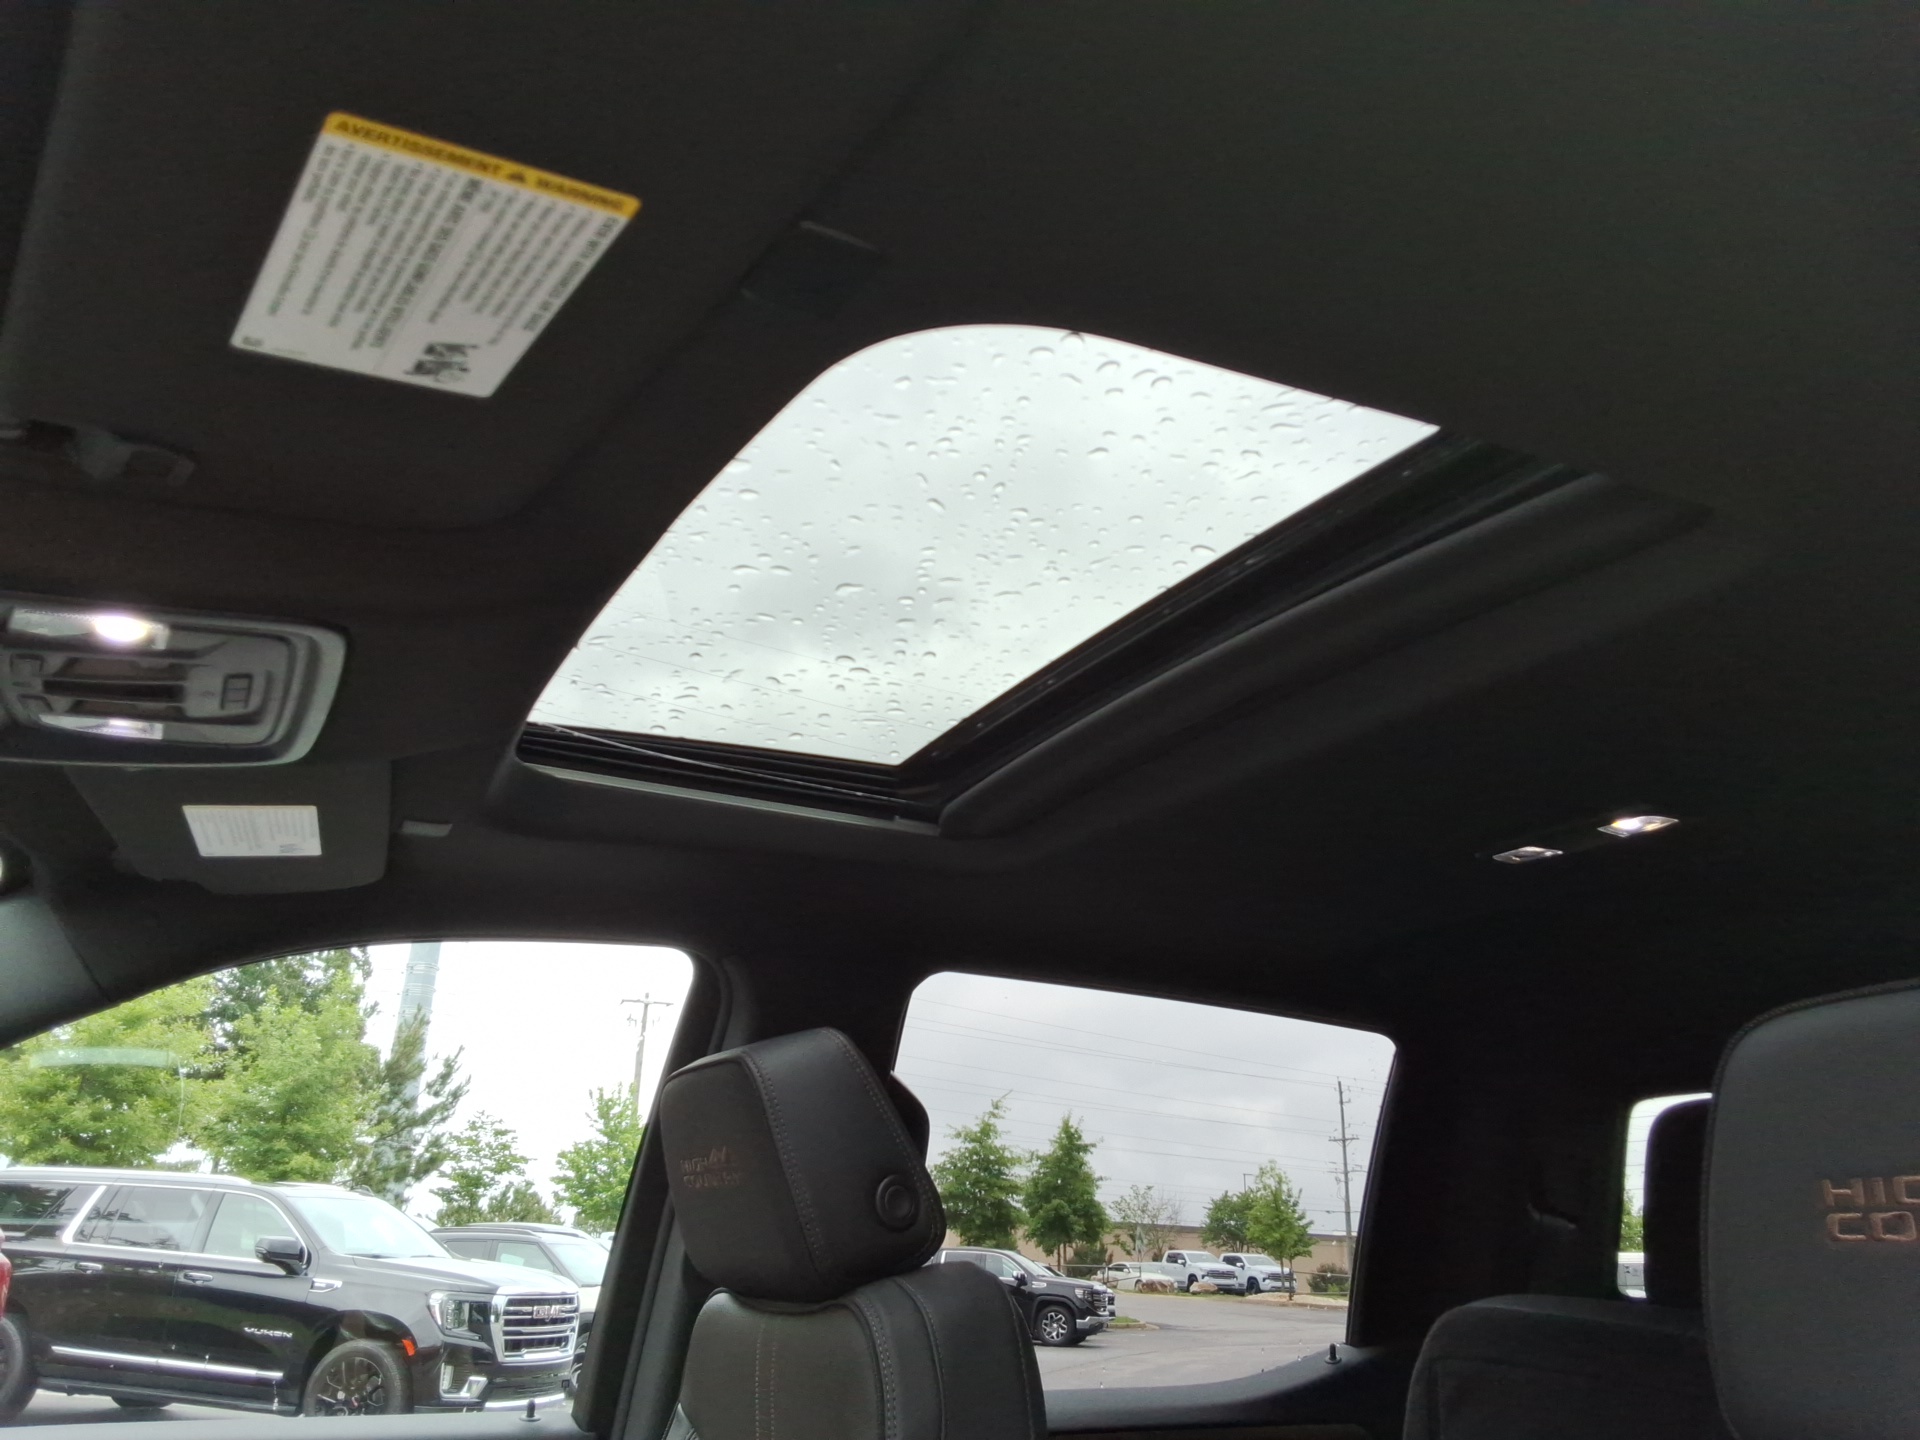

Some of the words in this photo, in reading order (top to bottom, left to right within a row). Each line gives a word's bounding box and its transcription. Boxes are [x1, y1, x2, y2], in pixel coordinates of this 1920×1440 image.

[335, 120, 501, 175] AVERTISSEMENT
[533, 1305, 567, 1319] GMC
[243, 1327, 293, 1338] YUKON
